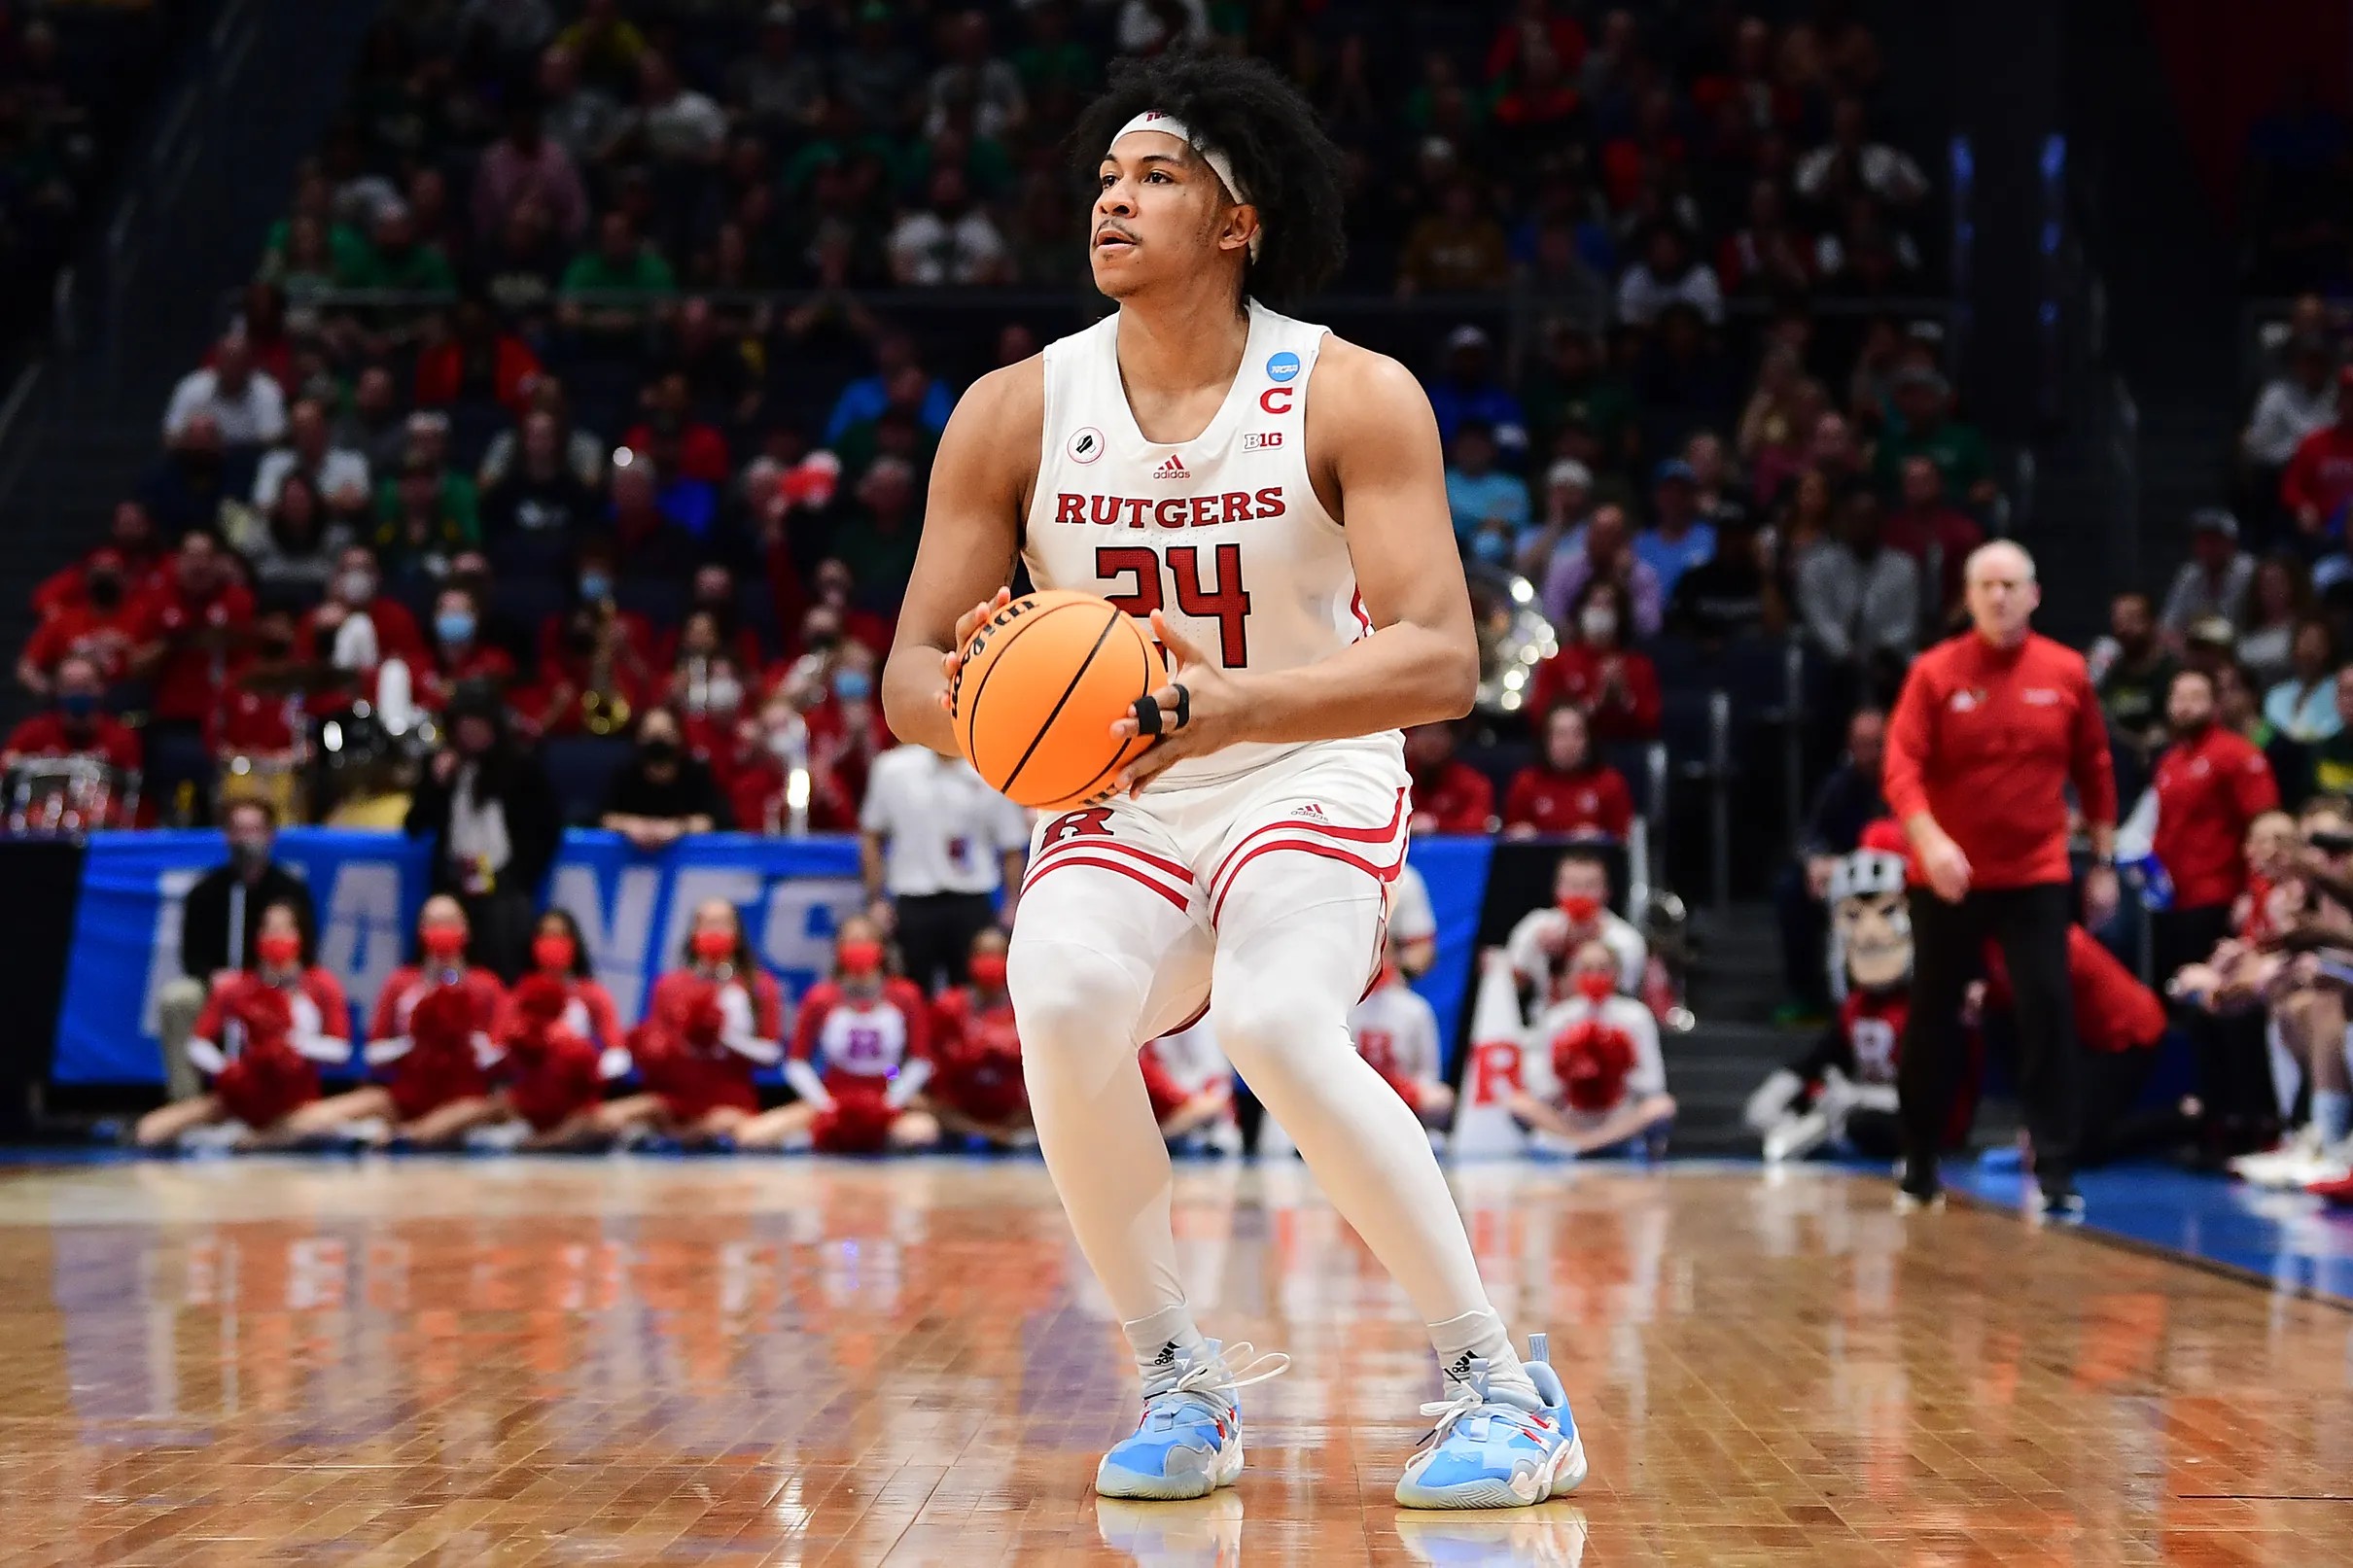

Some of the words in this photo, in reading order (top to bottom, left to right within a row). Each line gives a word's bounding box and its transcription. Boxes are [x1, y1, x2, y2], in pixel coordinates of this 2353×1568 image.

[1259, 387, 1293, 415] C
[1153, 468, 1191, 479] adidas
[1055, 487, 1286, 529] RUTGERS
[1095, 543, 1251, 669] 24
[1038, 807, 1114, 856] R
[1290, 809, 1329, 822] adidas
[1468, 1040, 1524, 1106] R
